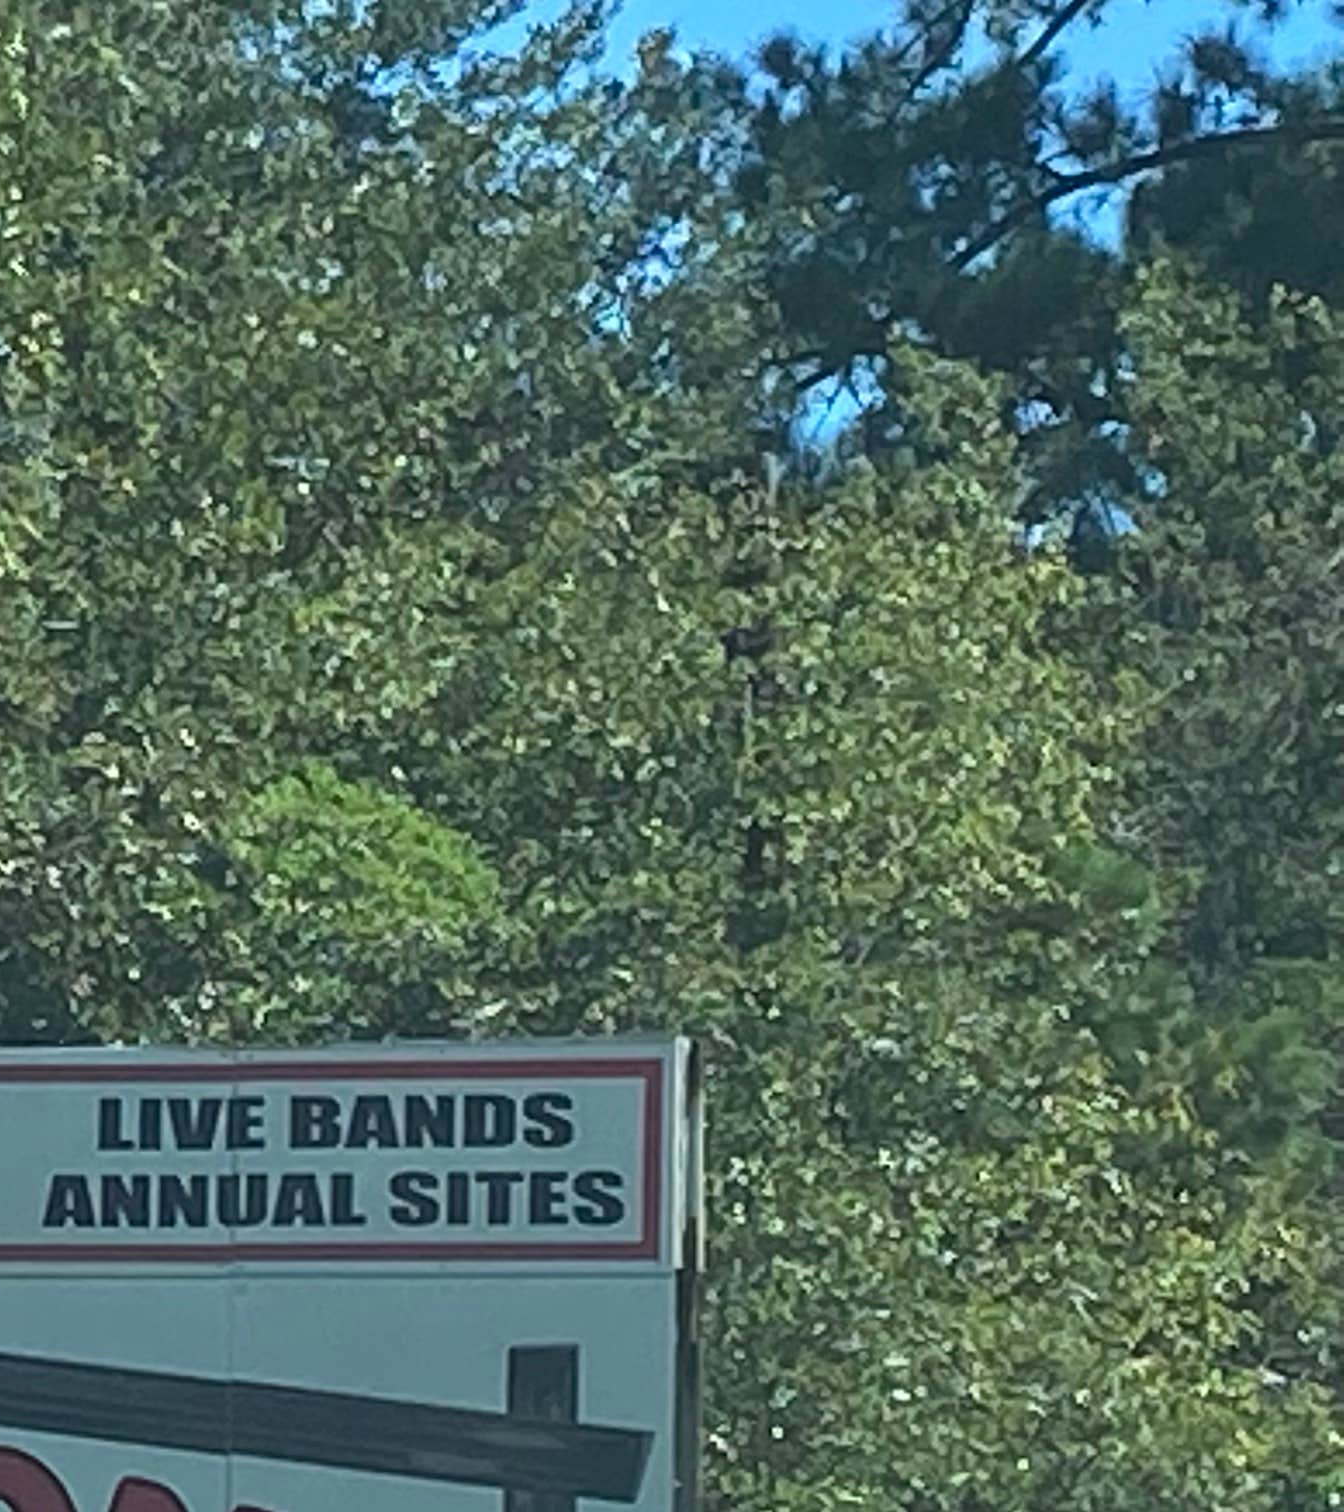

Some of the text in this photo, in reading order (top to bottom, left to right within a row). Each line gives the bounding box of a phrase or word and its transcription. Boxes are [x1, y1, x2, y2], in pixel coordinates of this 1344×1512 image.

[96, 1092, 575, 1152] LIVE BANDS
[42, 1170, 626, 1228] ANNUAL SITES
